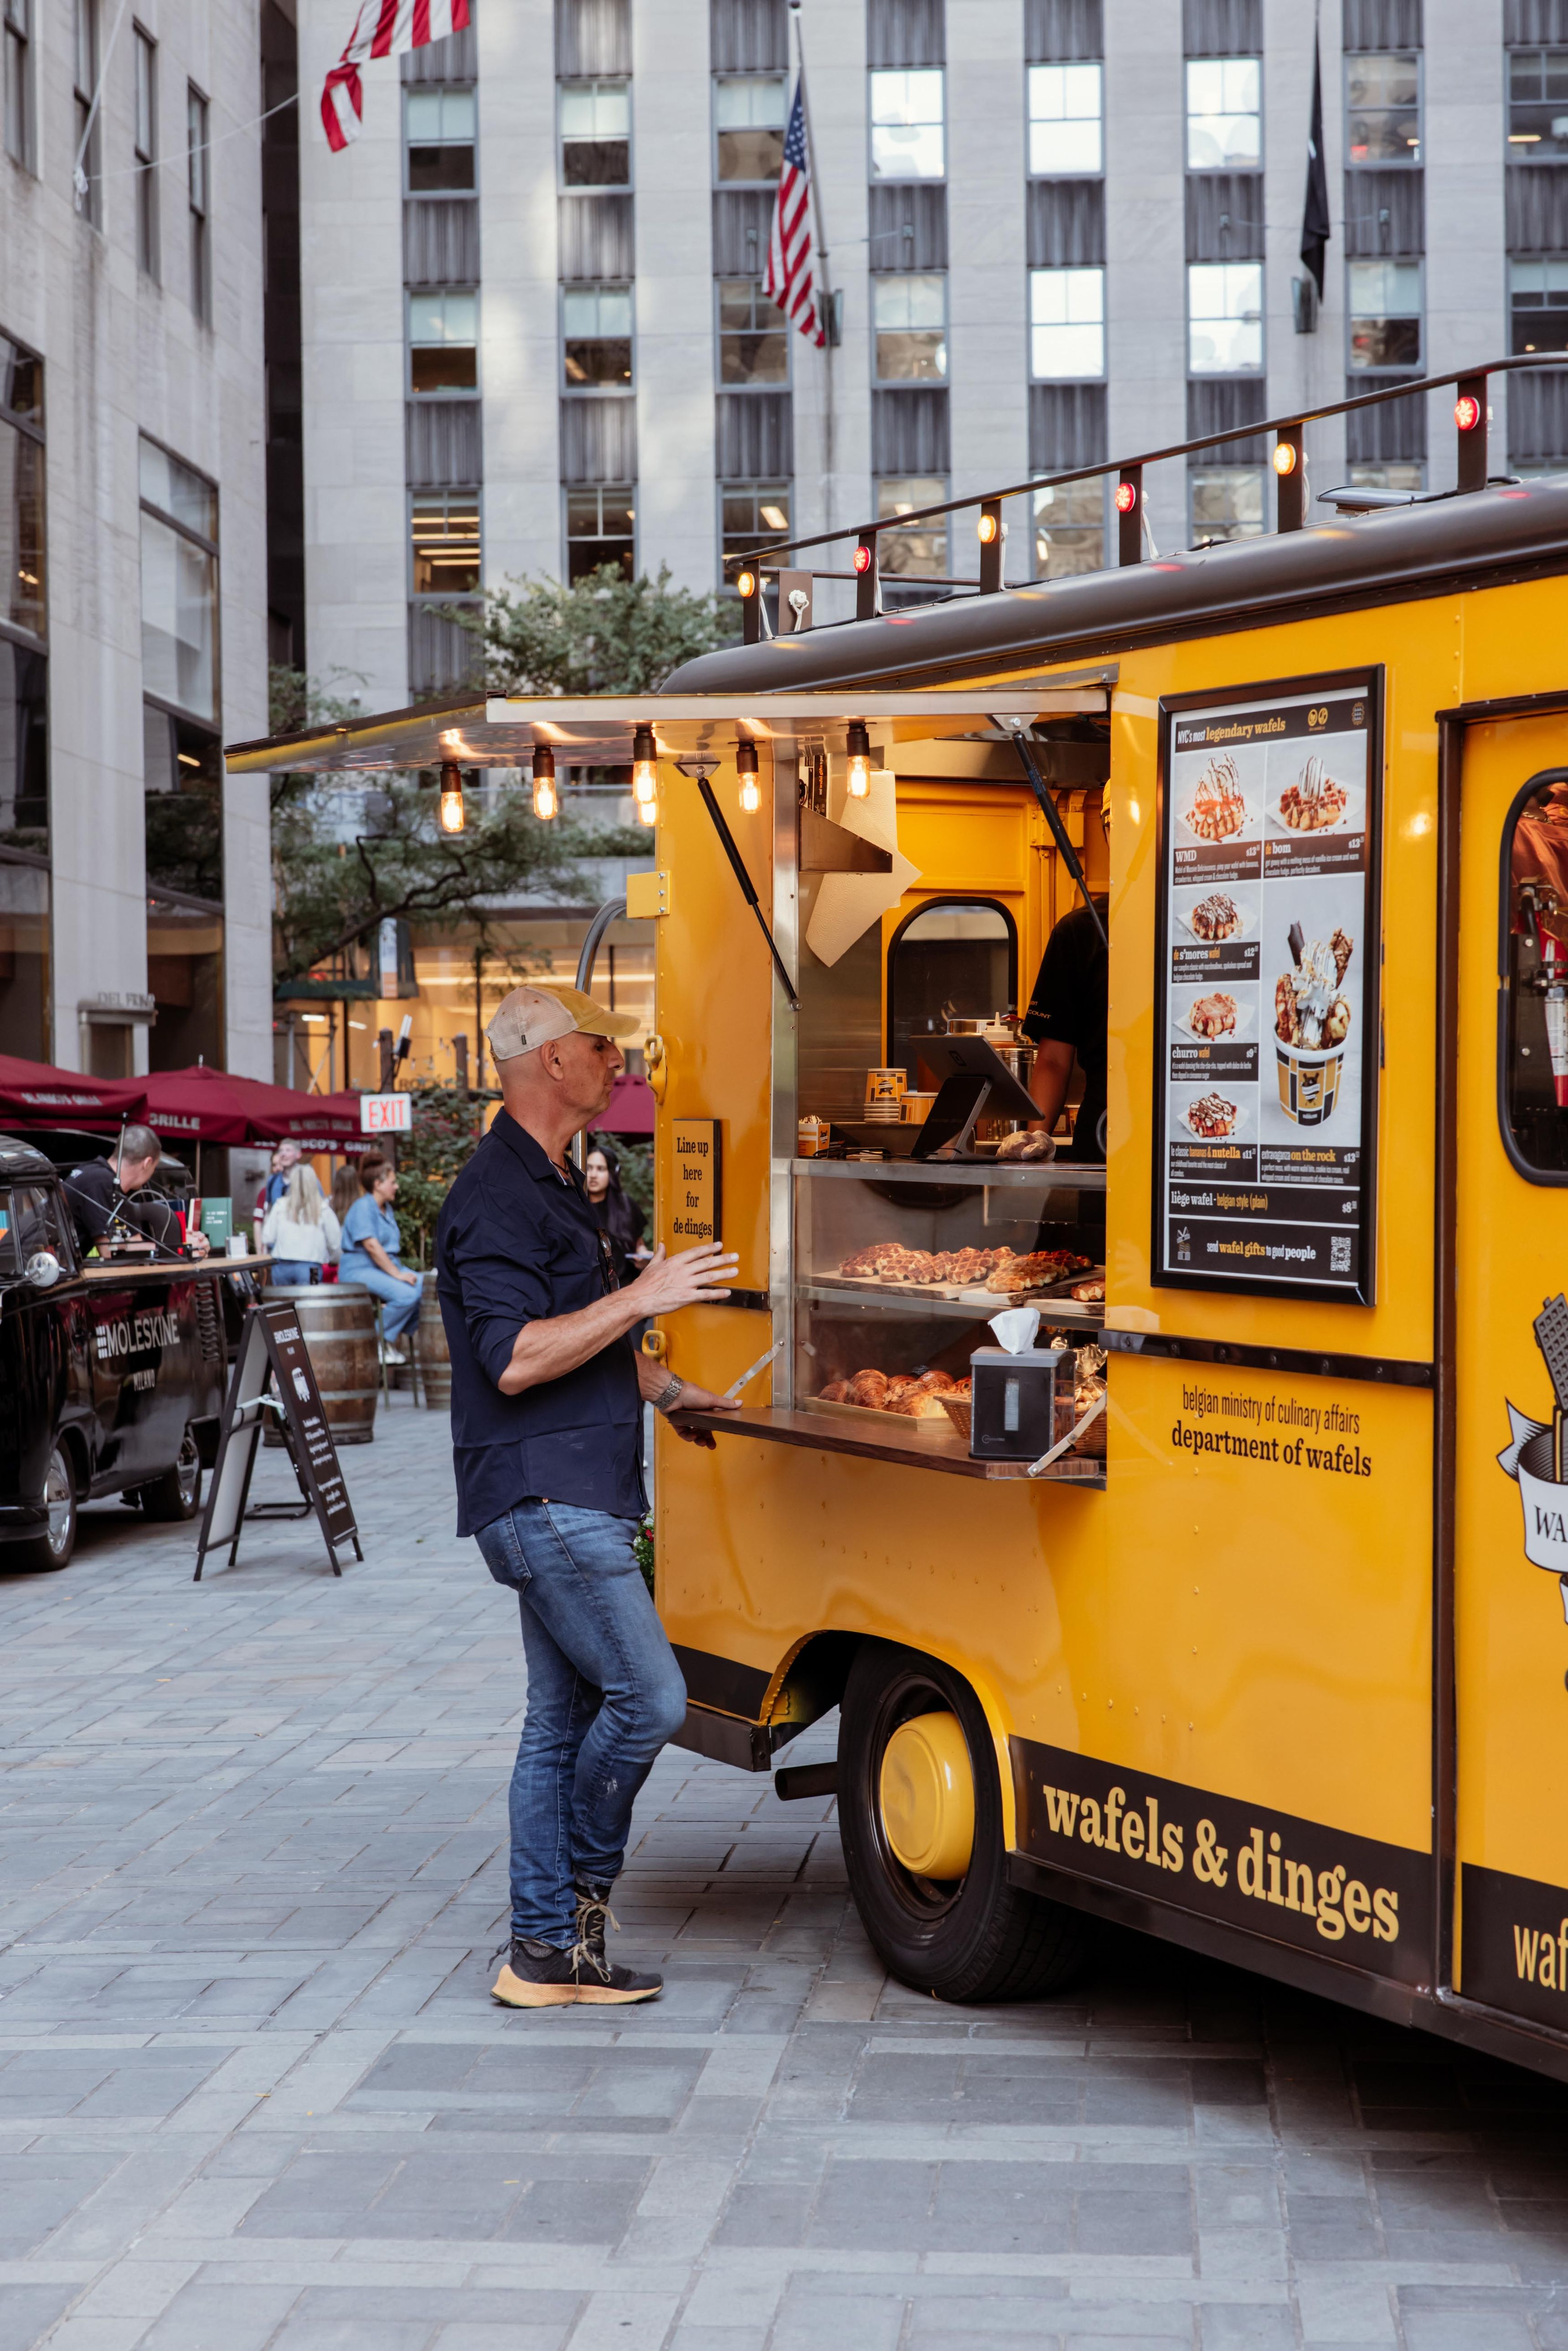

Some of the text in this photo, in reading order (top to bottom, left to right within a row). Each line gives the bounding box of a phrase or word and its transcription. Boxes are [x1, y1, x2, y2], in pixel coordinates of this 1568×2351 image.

[1178, 717, 1285, 744] NYC's most legendary wafels
[1176, 850, 1197, 863] WMD
[1272, 842, 1291, 854] bom
[1180, 949, 1208, 960] s'mores
[1172, 1047, 1198, 1058] churro
[369, 1100, 405, 1129] EXIT
[677, 1137, 708, 1157] Line up
[1212, 1146, 1240, 1158] nutella
[1291, 1151, 1300, 1161] on
[1301, 1148, 1316, 1161] the
[1317, 1149, 1336, 1162] rock
[683, 1164, 702, 1180] here
[686, 1191, 699, 1207] for
[1171, 1191, 1190, 1207] liège
[1191, 1193, 1213, 1206] wafel
[1217, 1193, 1236, 1209] belgian
[1236, 1195, 1249, 1210] style
[1250, 1194, 1268, 1211] (plain)
[674, 1217, 712, 1239] de dinges
[1207, 1240, 1218, 1252] send
[1219, 1241, 1243, 1254] wafel
[1244, 1242, 1265, 1257] gifts
[1284, 1245, 1316, 1261] people
[106, 1312, 180, 1357] MOLESKINE
[133, 1369, 155, 1391] MILANO
[1183, 1384, 1360, 1434] belgian ministry of culinary affairs
[1172, 1420, 1371, 1477] department of wafels
[1043, 1785, 1399, 1942] wafels & dinges
[1513, 1917, 1568, 1992] waf
